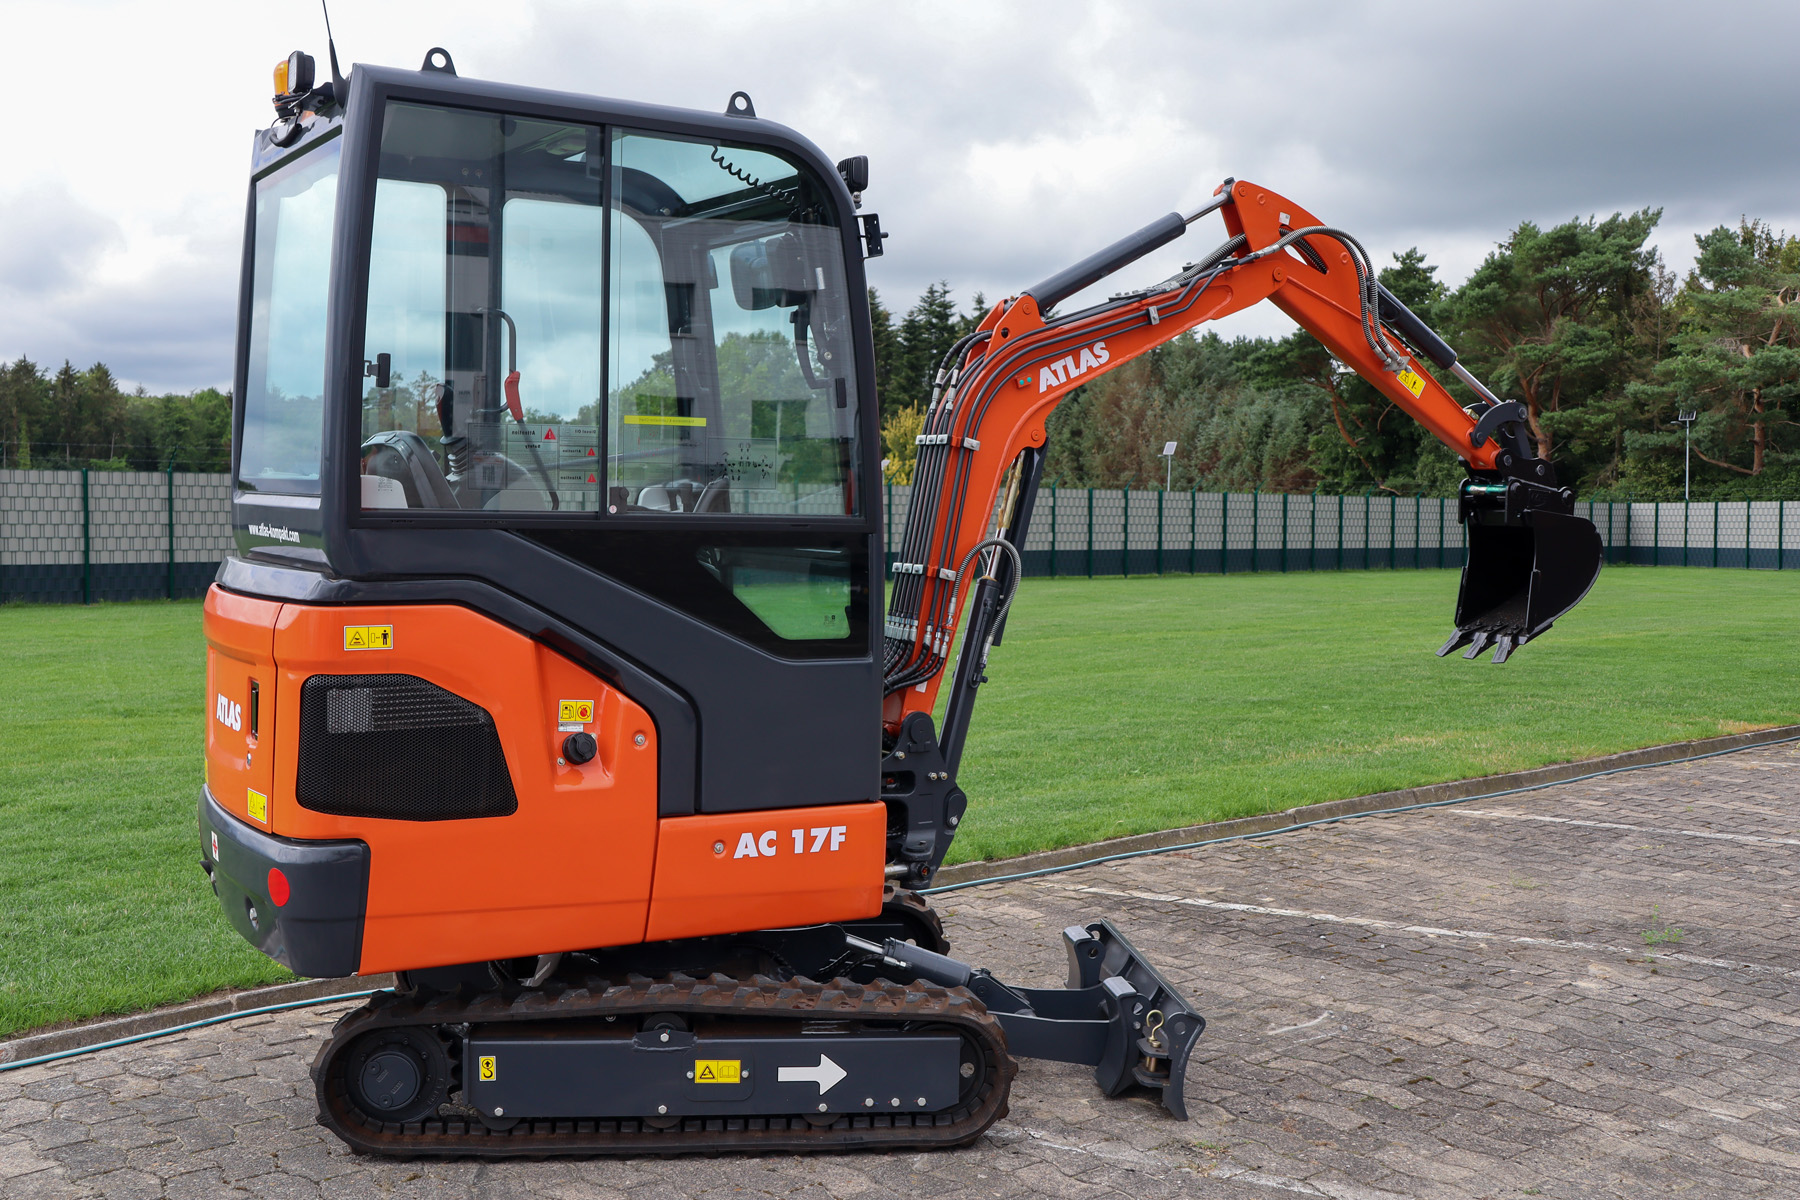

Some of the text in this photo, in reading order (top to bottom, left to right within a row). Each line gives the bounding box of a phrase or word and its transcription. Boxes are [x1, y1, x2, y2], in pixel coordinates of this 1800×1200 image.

[1039, 341, 1110, 394] ATLAS
[216, 692, 242, 732] ATLAS
[733, 825, 847, 859] AC 17F
